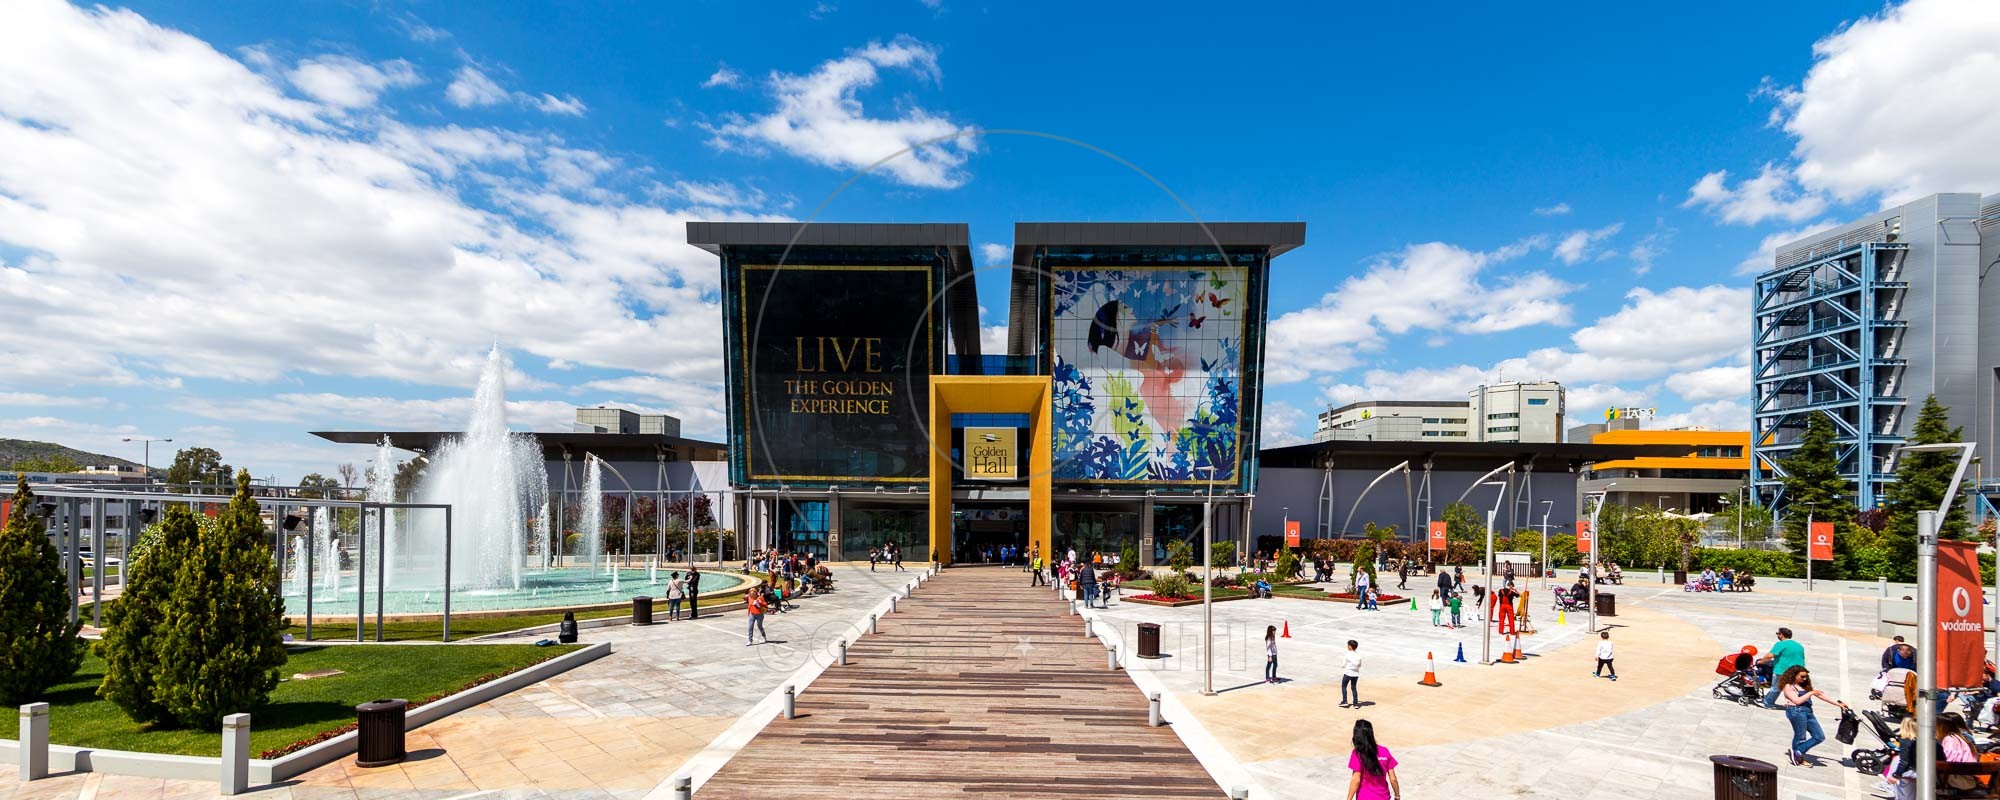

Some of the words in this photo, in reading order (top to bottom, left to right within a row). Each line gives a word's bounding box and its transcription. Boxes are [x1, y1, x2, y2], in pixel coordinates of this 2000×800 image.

[795, 336, 882, 373] LIVE
[784, 380, 818, 395] THE
[822, 380, 894, 396] GOLDEN
[791, 399, 889, 415] EXPERIENCE
[973, 445, 1008, 457] Golden
[973, 456, 1009, 474] Hall
[1940, 619, 1982, 632] vodafone
